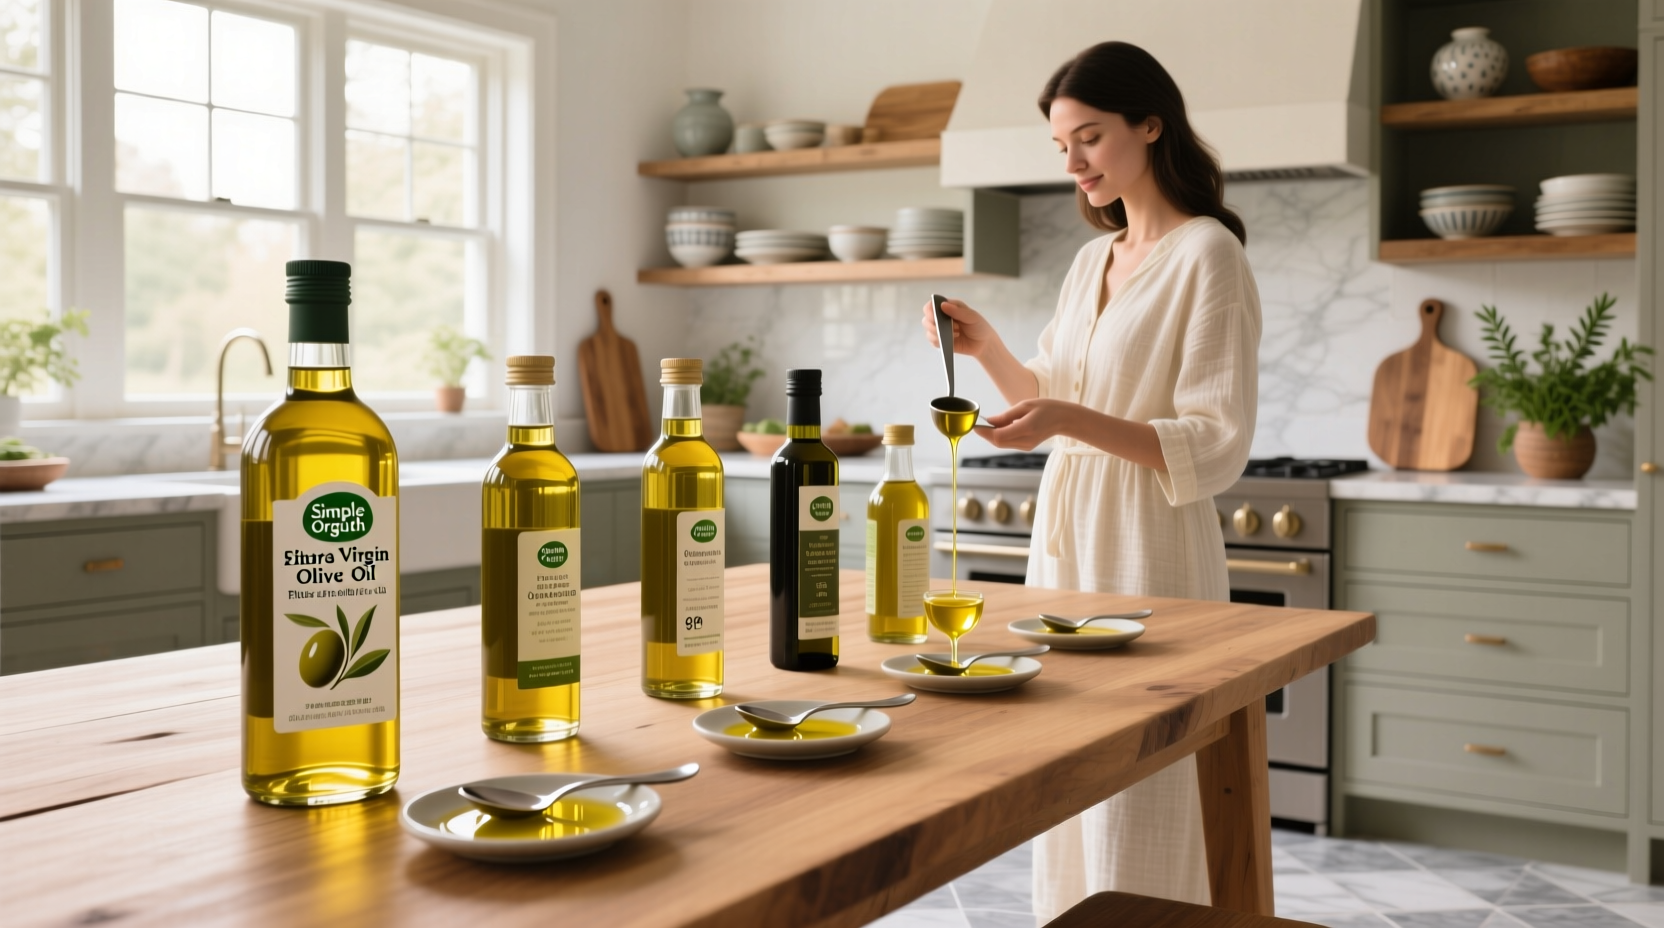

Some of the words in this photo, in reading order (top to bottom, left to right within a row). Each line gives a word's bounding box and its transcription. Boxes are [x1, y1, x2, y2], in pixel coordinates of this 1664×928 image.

[311, 501, 365, 522] Simple
[338, 546, 389, 565] Virgin
[296, 567, 343, 584] Olive
[351, 564, 375, 582] Oil
